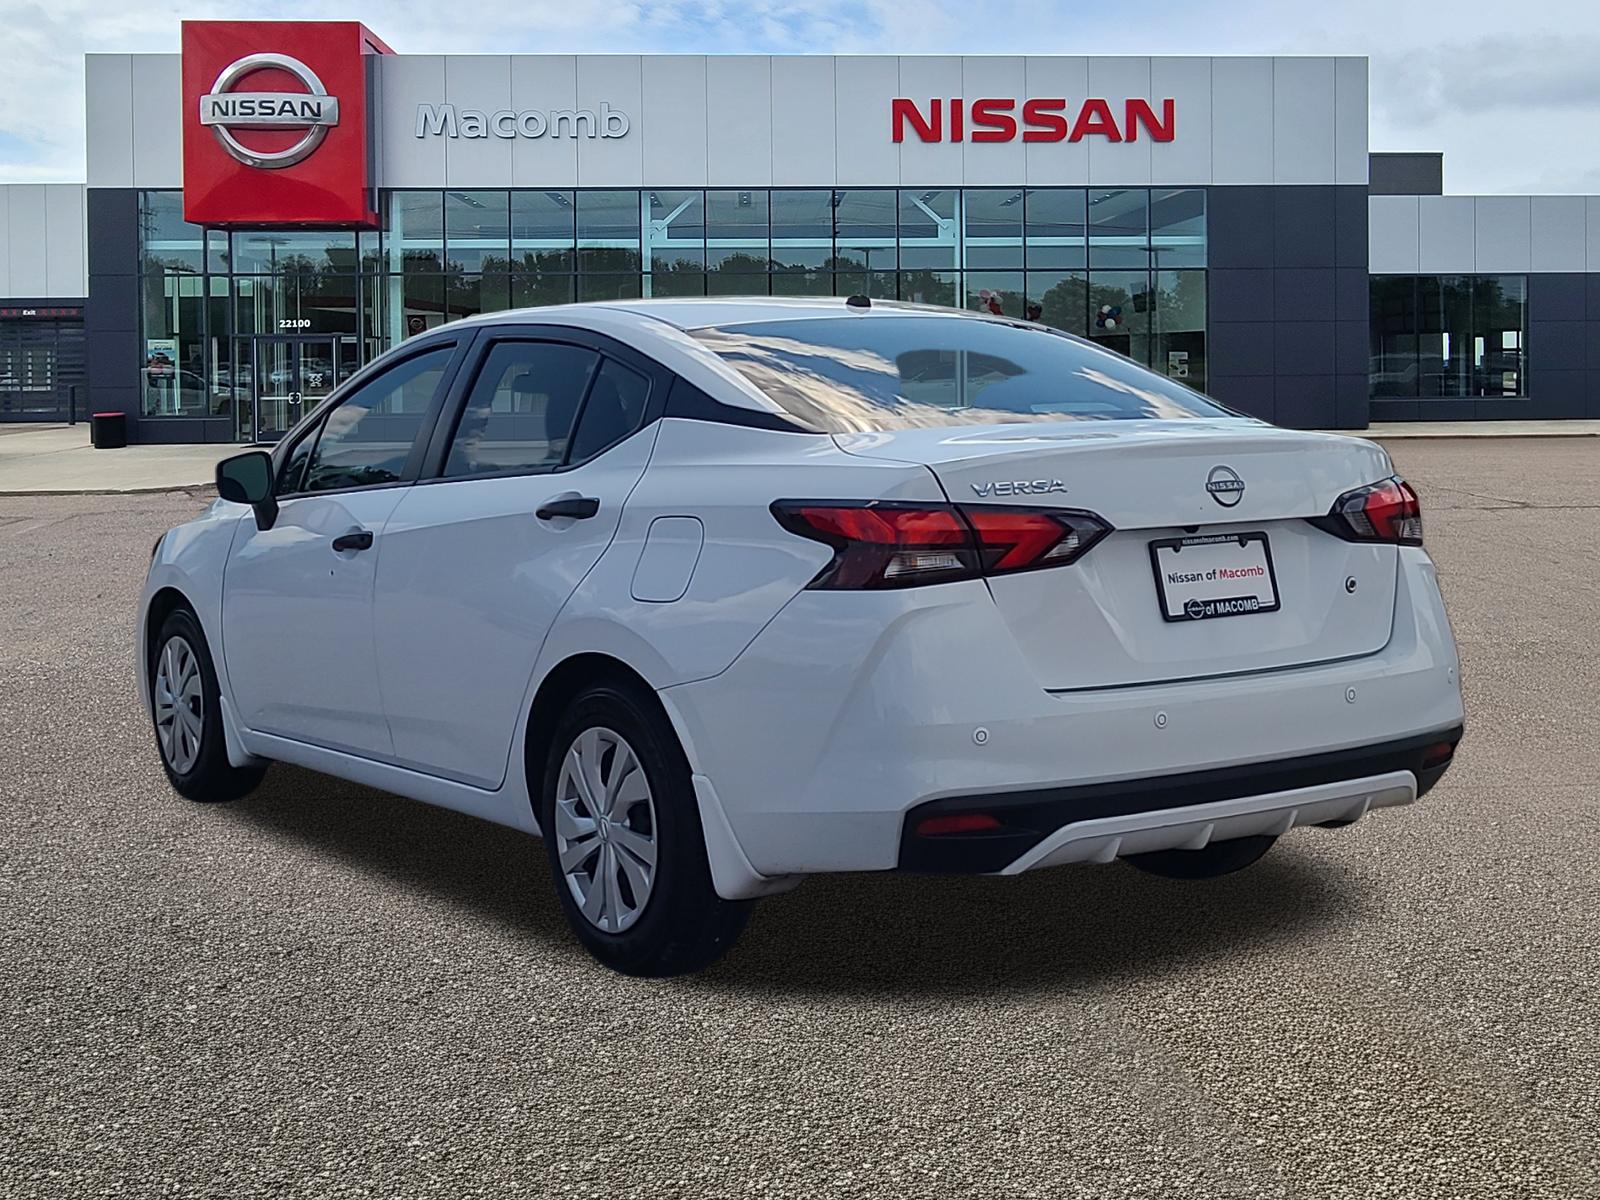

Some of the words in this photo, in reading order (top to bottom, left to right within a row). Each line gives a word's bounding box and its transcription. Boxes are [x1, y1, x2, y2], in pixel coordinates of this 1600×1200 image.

[211, 100, 322, 118] NISSAN
[415, 102, 630, 139] Macomb
[892, 98, 1176, 143] NISSAN
[279, 319, 311, 328] 22100
[970, 479, 1067, 497] VERSA
[1207, 481, 1244, 491] NISSAN
[1168, 572, 1203, 584] Nissan
[1206, 569, 1216, 581] of
[1219, 565, 1264, 580] Macomb
[1205, 603, 1215, 615] of
[1216, 599, 1259, 614] MACOMB
